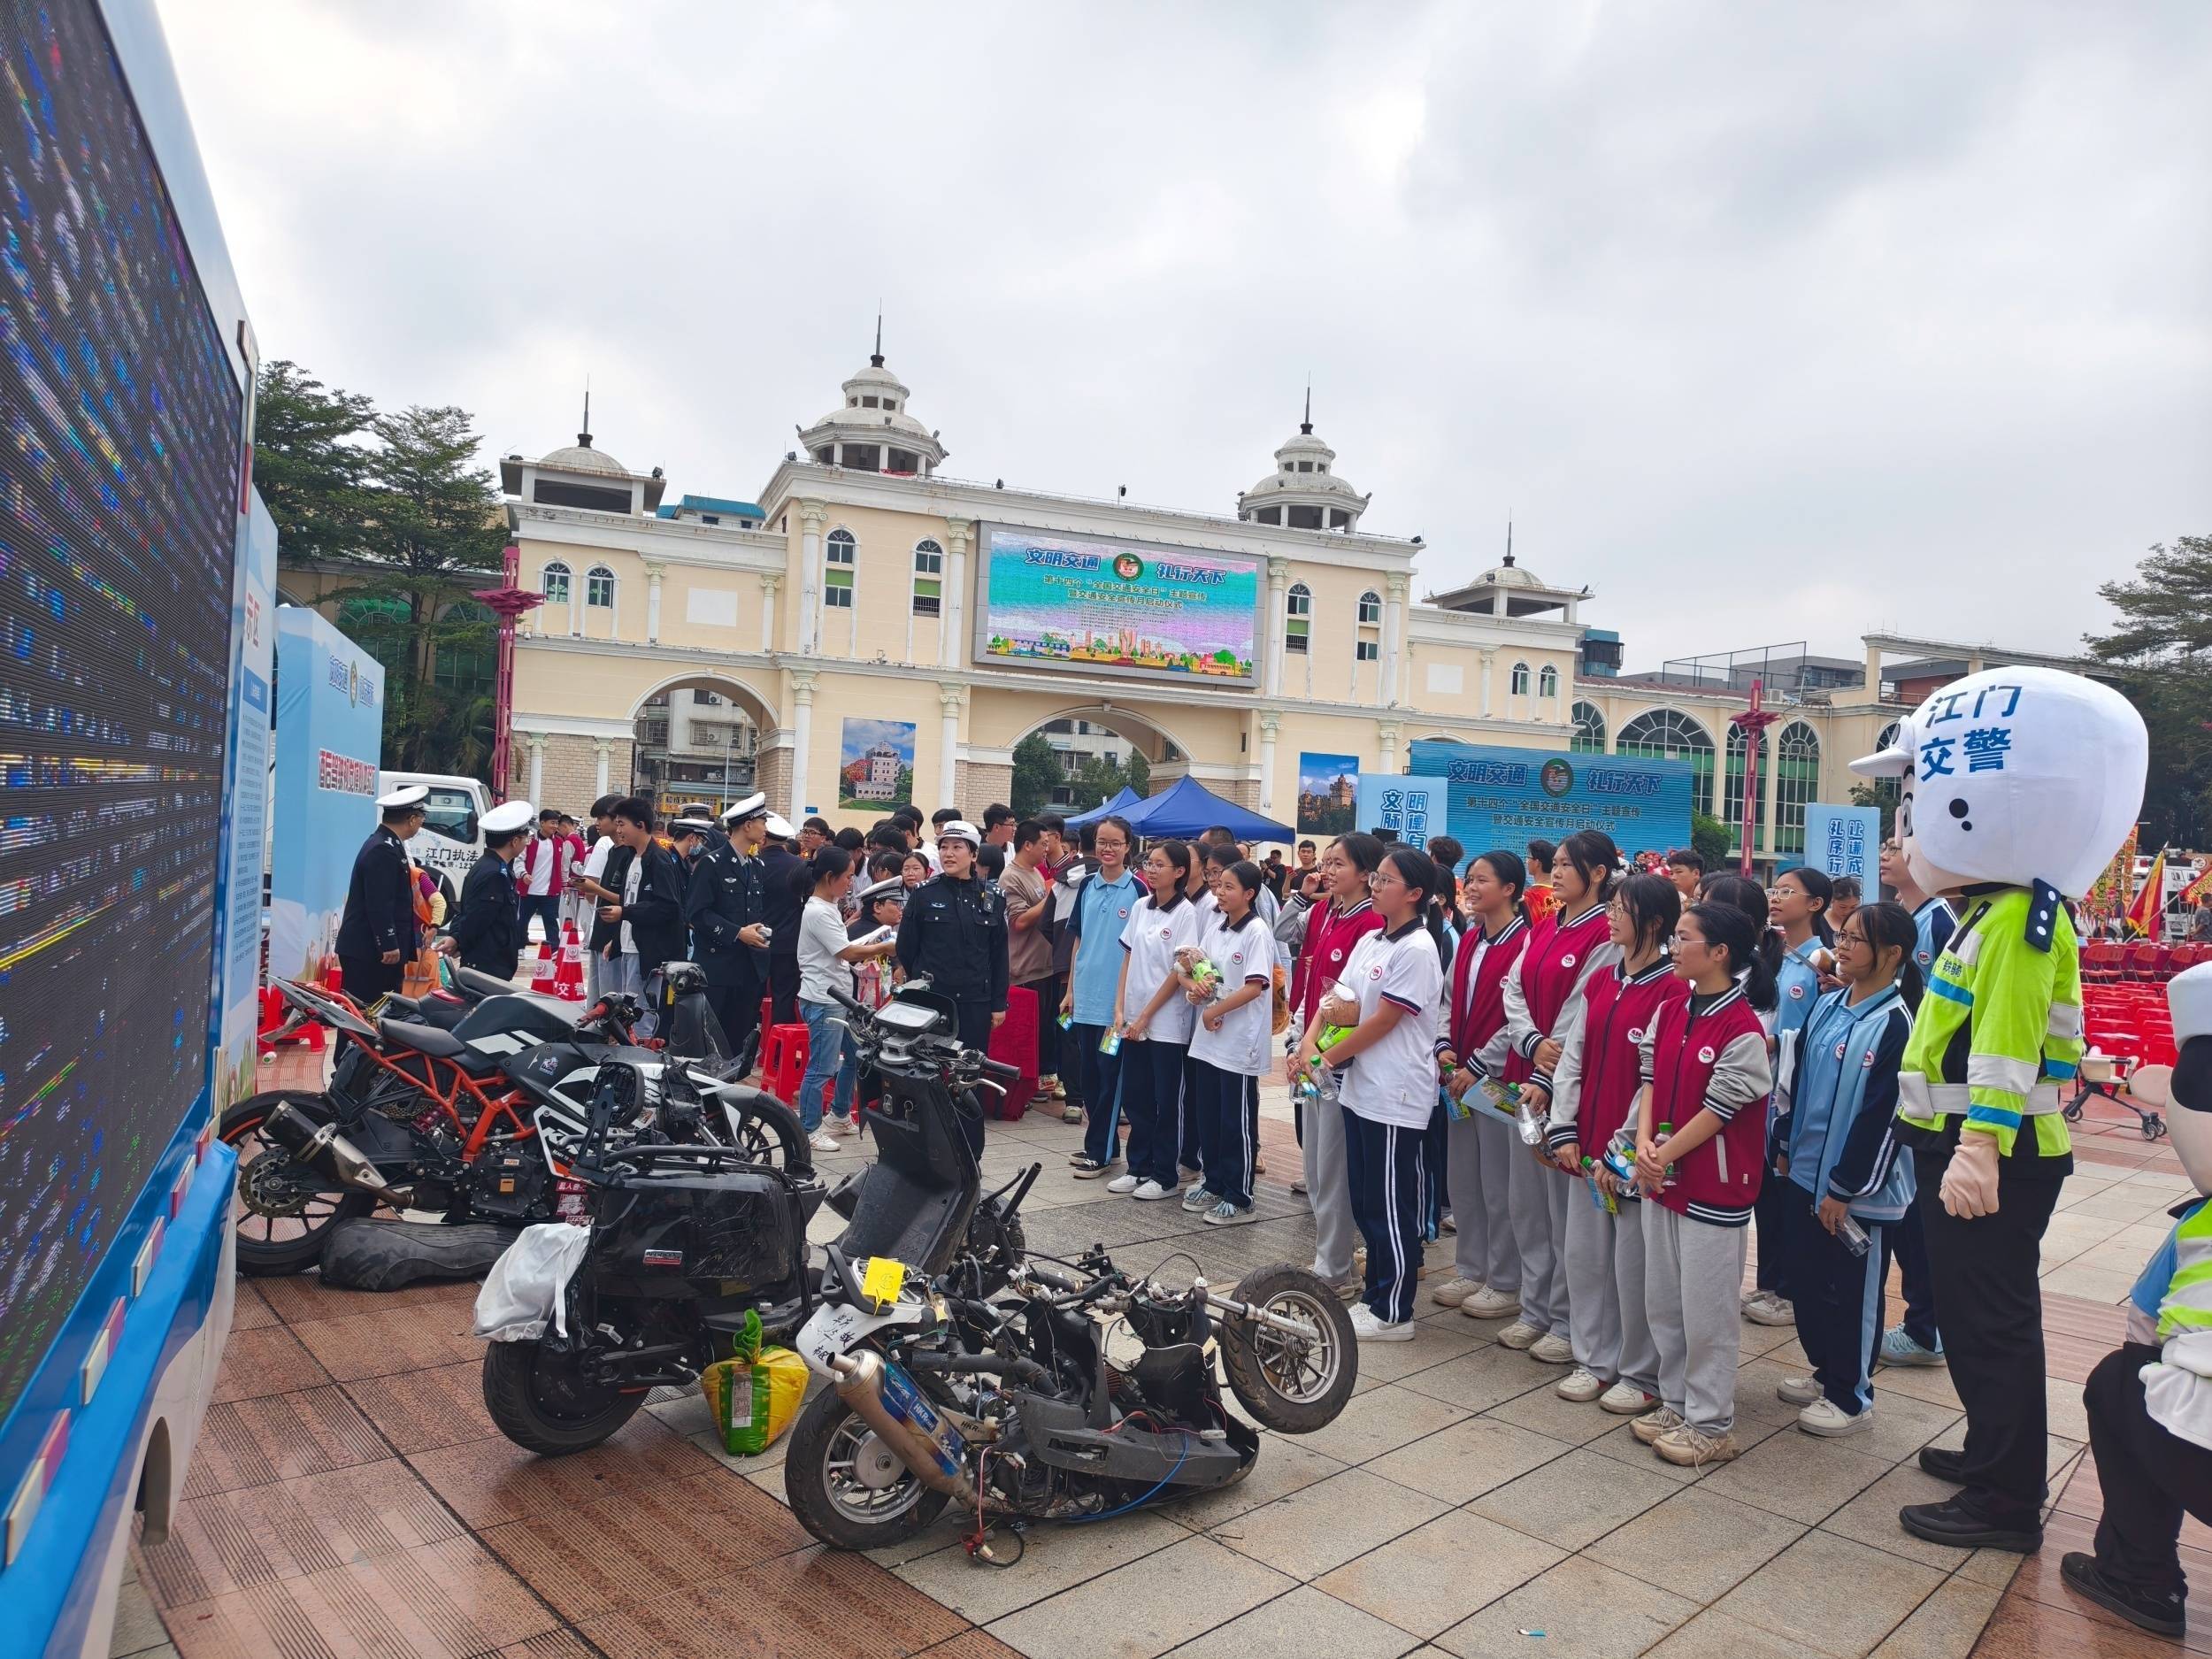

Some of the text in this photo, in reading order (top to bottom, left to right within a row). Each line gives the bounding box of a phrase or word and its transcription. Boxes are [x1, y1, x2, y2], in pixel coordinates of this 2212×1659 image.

[1025, 548, 1101, 572] 文明交通
[1156, 563, 1226, 585] 礼行天下
[1925, 685, 2023, 729] 江门
[1920, 726, 2012, 782] 交警
[1447, 759, 1529, 787] 文明交通
[1586, 769, 1664, 795] 礼行天下
[1380, 789, 1403, 843] 文脉
[1492, 814, 1617, 832] 暨交通安全宣传月启动仪式
[426, 847, 479, 862] 江门执法
[1827, 818, 1845, 881] 礼序行
[557, 982, 585, 996] 交警
[913, 1403, 930, 1421] HKR
[960, 1420, 979, 1432] HKR
